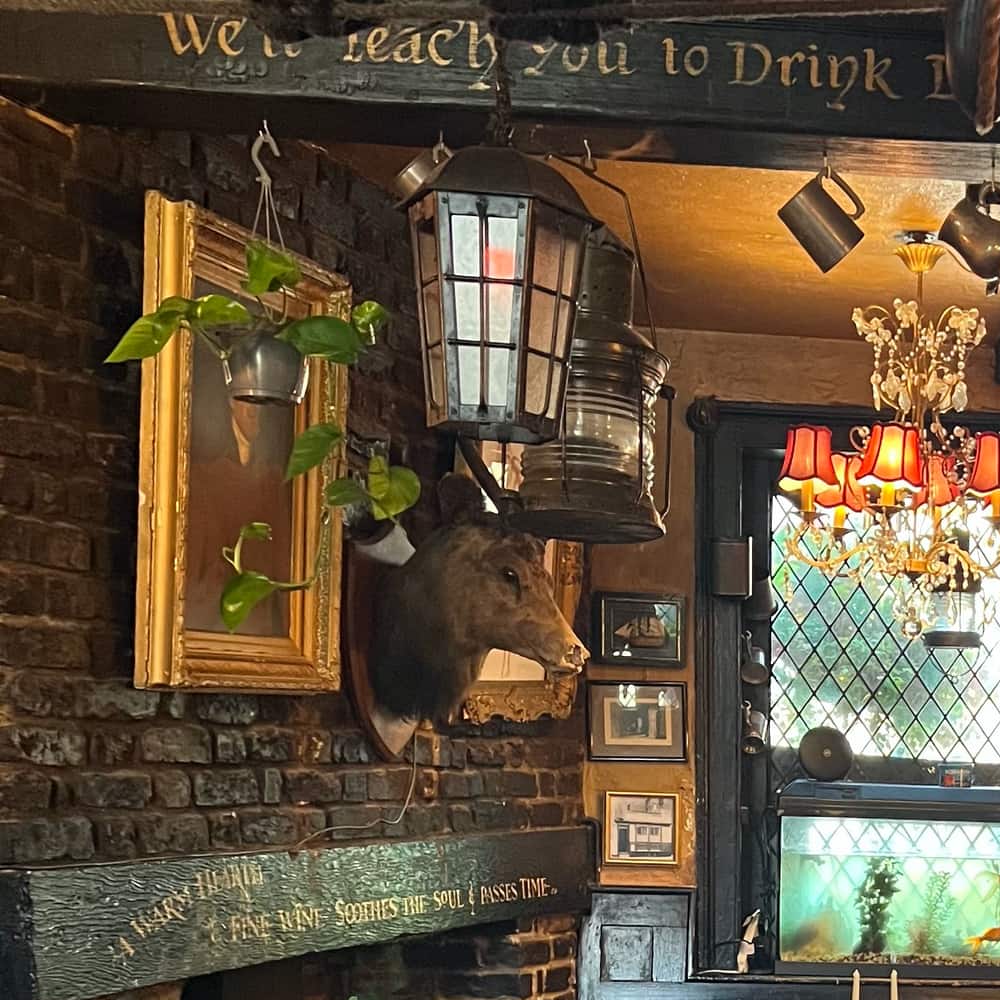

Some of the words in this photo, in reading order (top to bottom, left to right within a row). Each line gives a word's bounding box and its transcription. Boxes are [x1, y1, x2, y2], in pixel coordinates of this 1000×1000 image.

[662, 37, 709, 76] to
[726, 41, 903, 110] Drink
[335, 898, 399, 926] SOOTHES
[402, 894, 428, 915] THE
[480, 882, 518, 904] PASSES
